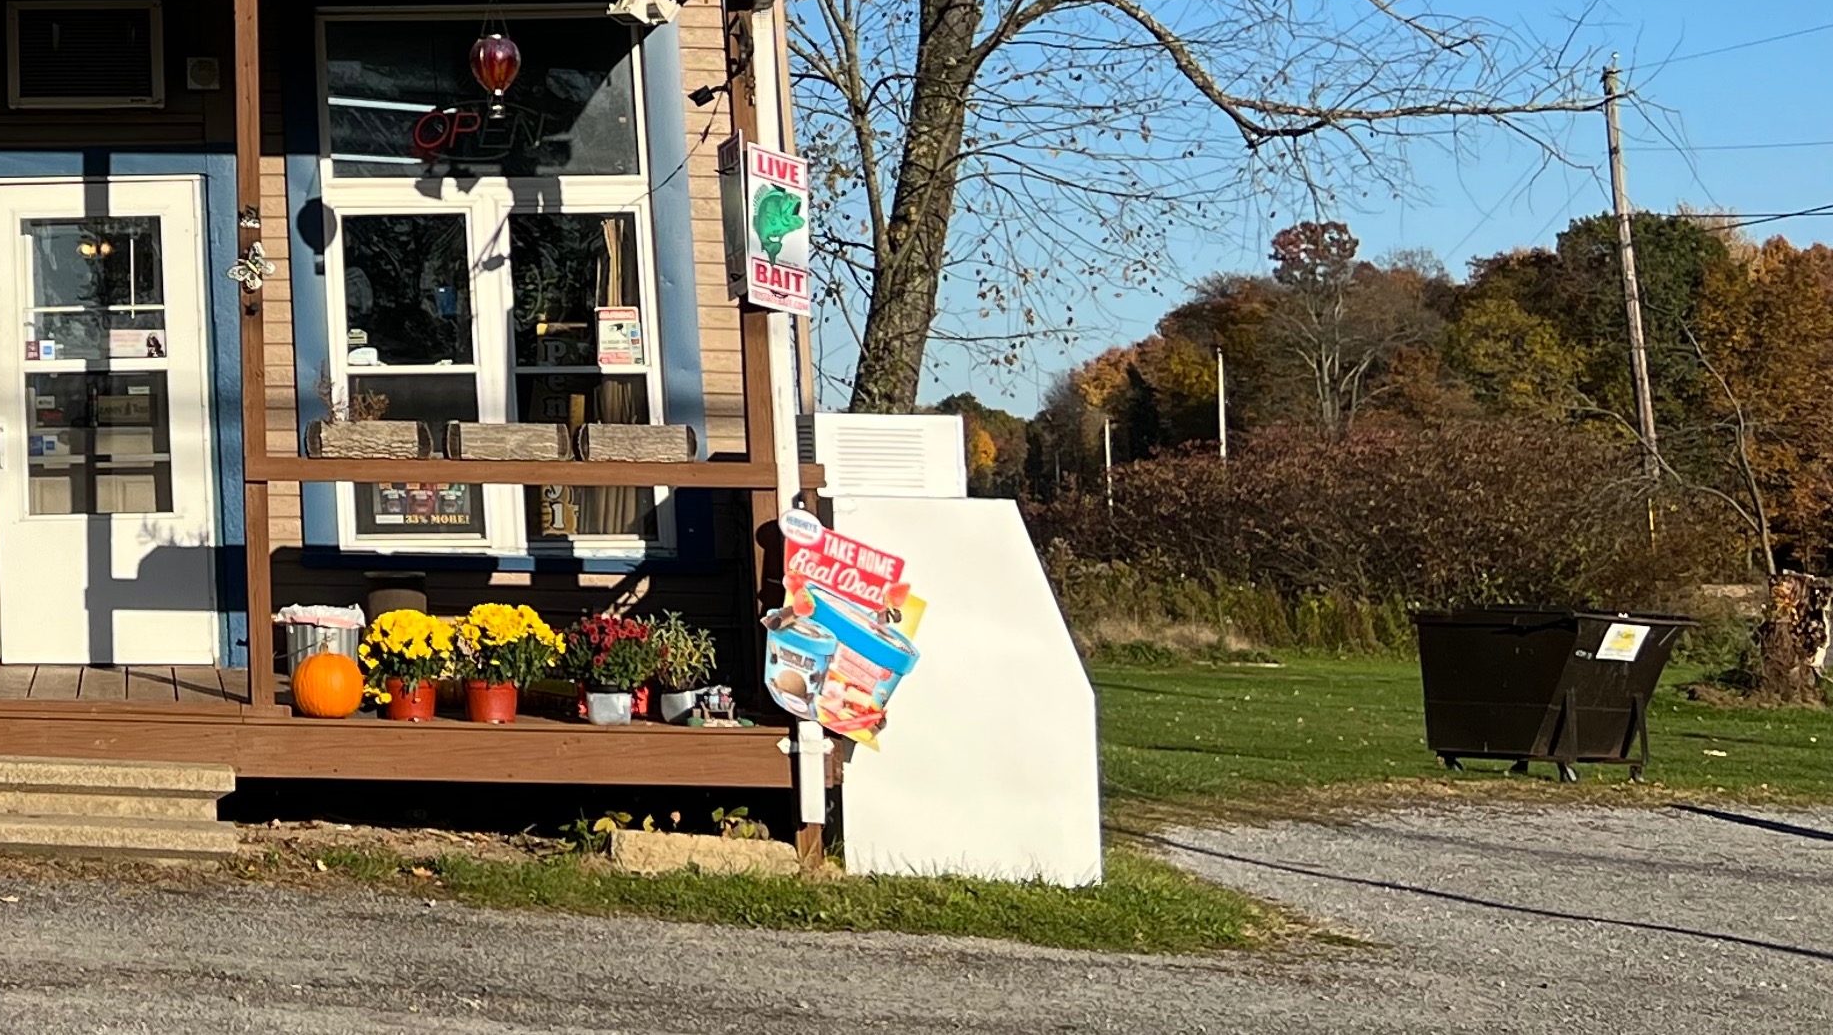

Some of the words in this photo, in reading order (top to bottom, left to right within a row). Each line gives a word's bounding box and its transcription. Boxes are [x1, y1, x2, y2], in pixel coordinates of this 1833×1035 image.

[414, 111, 546, 149] OPEN
[756, 155, 800, 184] LIVE
[755, 263, 804, 292] BAIT
[823, 533, 857, 566] TAKE
[856, 547, 897, 580] HOME
[789, 548, 840, 585] Real
[837, 567, 890, 604] Deal
